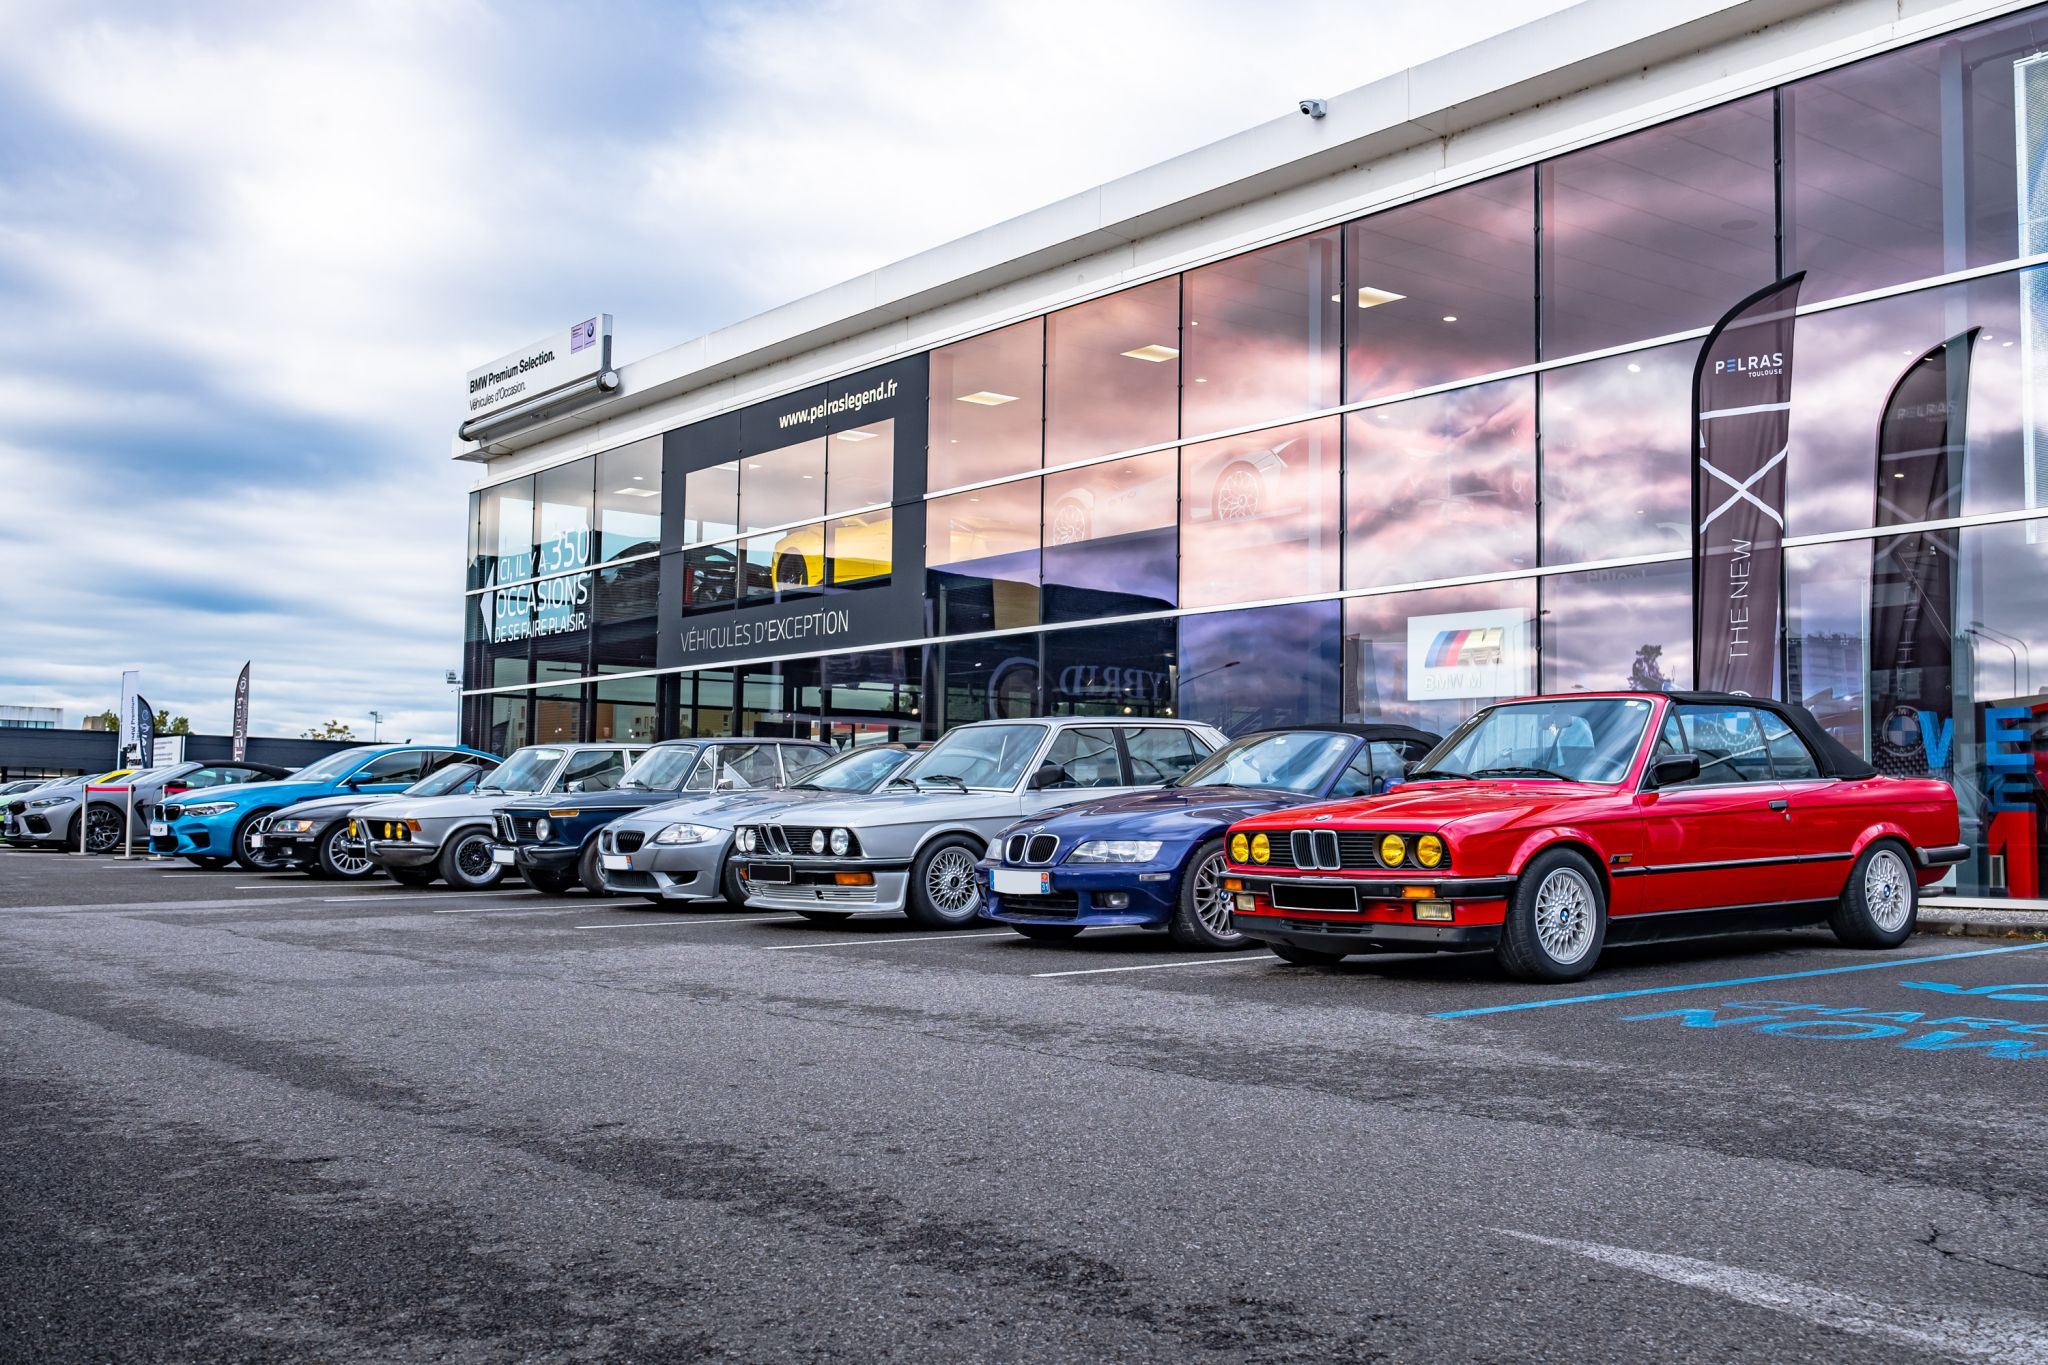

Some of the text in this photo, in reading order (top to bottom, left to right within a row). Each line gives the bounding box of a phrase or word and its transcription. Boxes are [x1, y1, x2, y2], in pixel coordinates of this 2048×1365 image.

[470, 351, 555, 393] BMW Premium Selection.
[1715, 352, 1783, 375] PELRAS
[1748, 369, 1783, 378] TOULOUSE
[779, 378, 898, 429] www.pelraslegend.fr
[550, 523, 590, 571] 350
[496, 574, 588, 618] OCCASIONS
[1729, 538, 1752, 665] THE NEW
[494, 612, 588, 644] DE SE FAIRE PLAISIR.
[680, 609, 849, 652] VÉHICULES D'EXCEPTION
